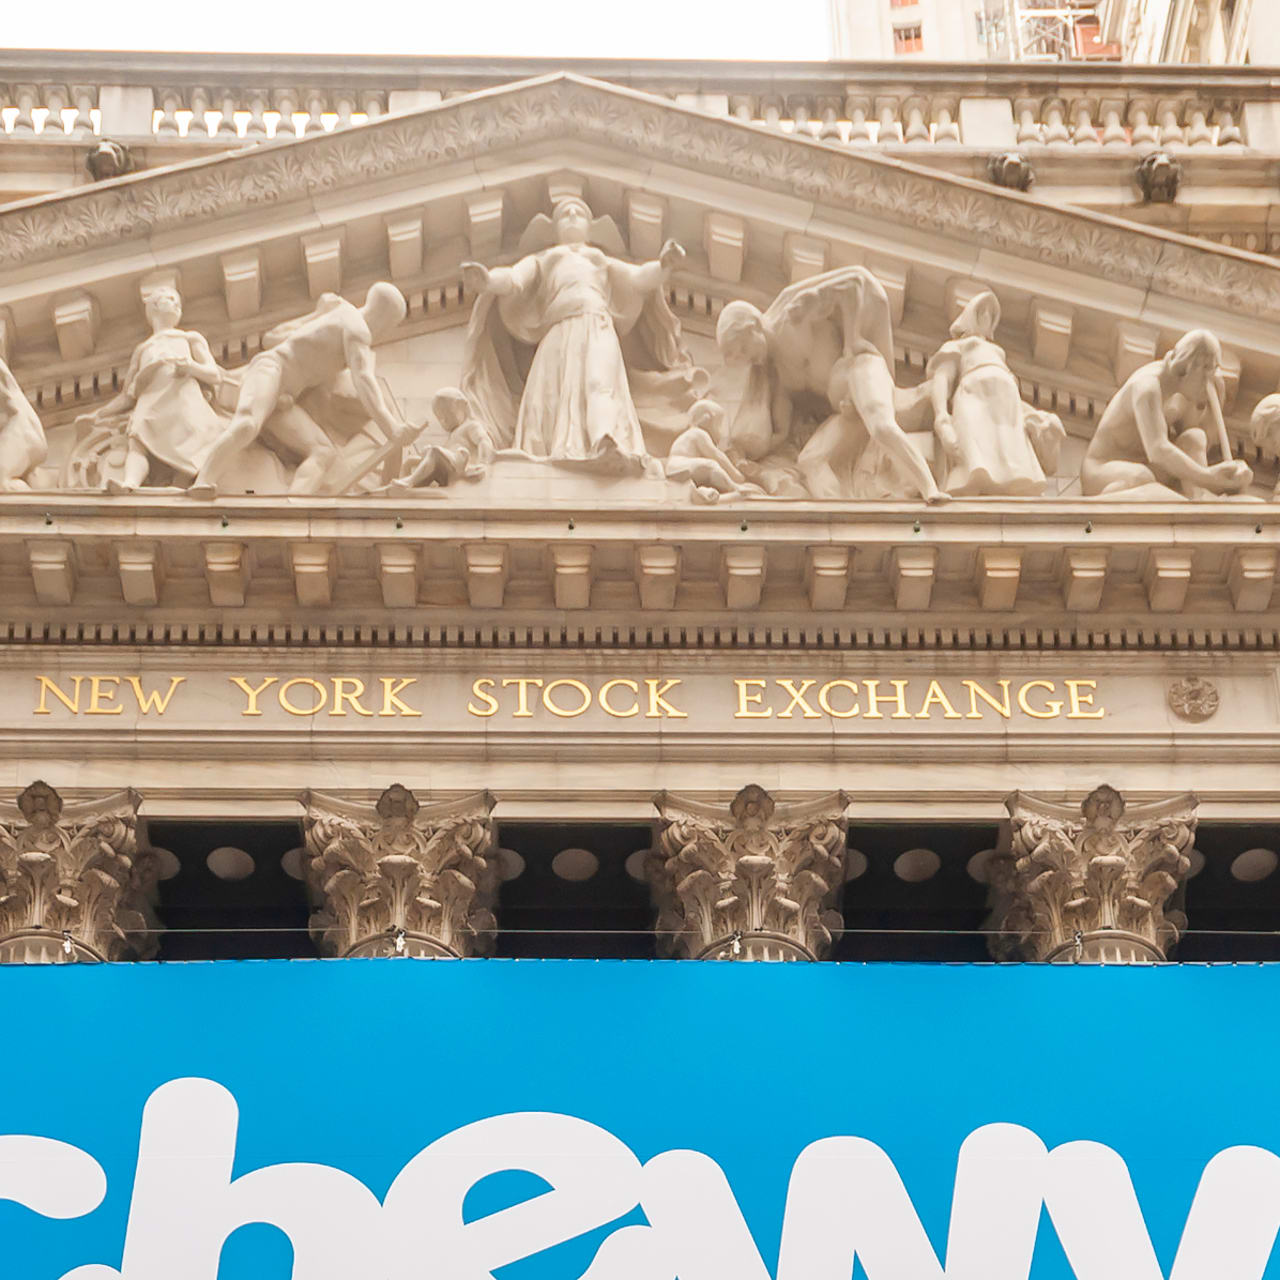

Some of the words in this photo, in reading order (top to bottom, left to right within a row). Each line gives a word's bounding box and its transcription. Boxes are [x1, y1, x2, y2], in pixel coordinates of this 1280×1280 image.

[33, 676, 186, 716] NEW
[229, 677, 422, 717] YORK
[468, 678, 688, 718] STOCK
[734, 678, 1106, 720] EXCHANGE
